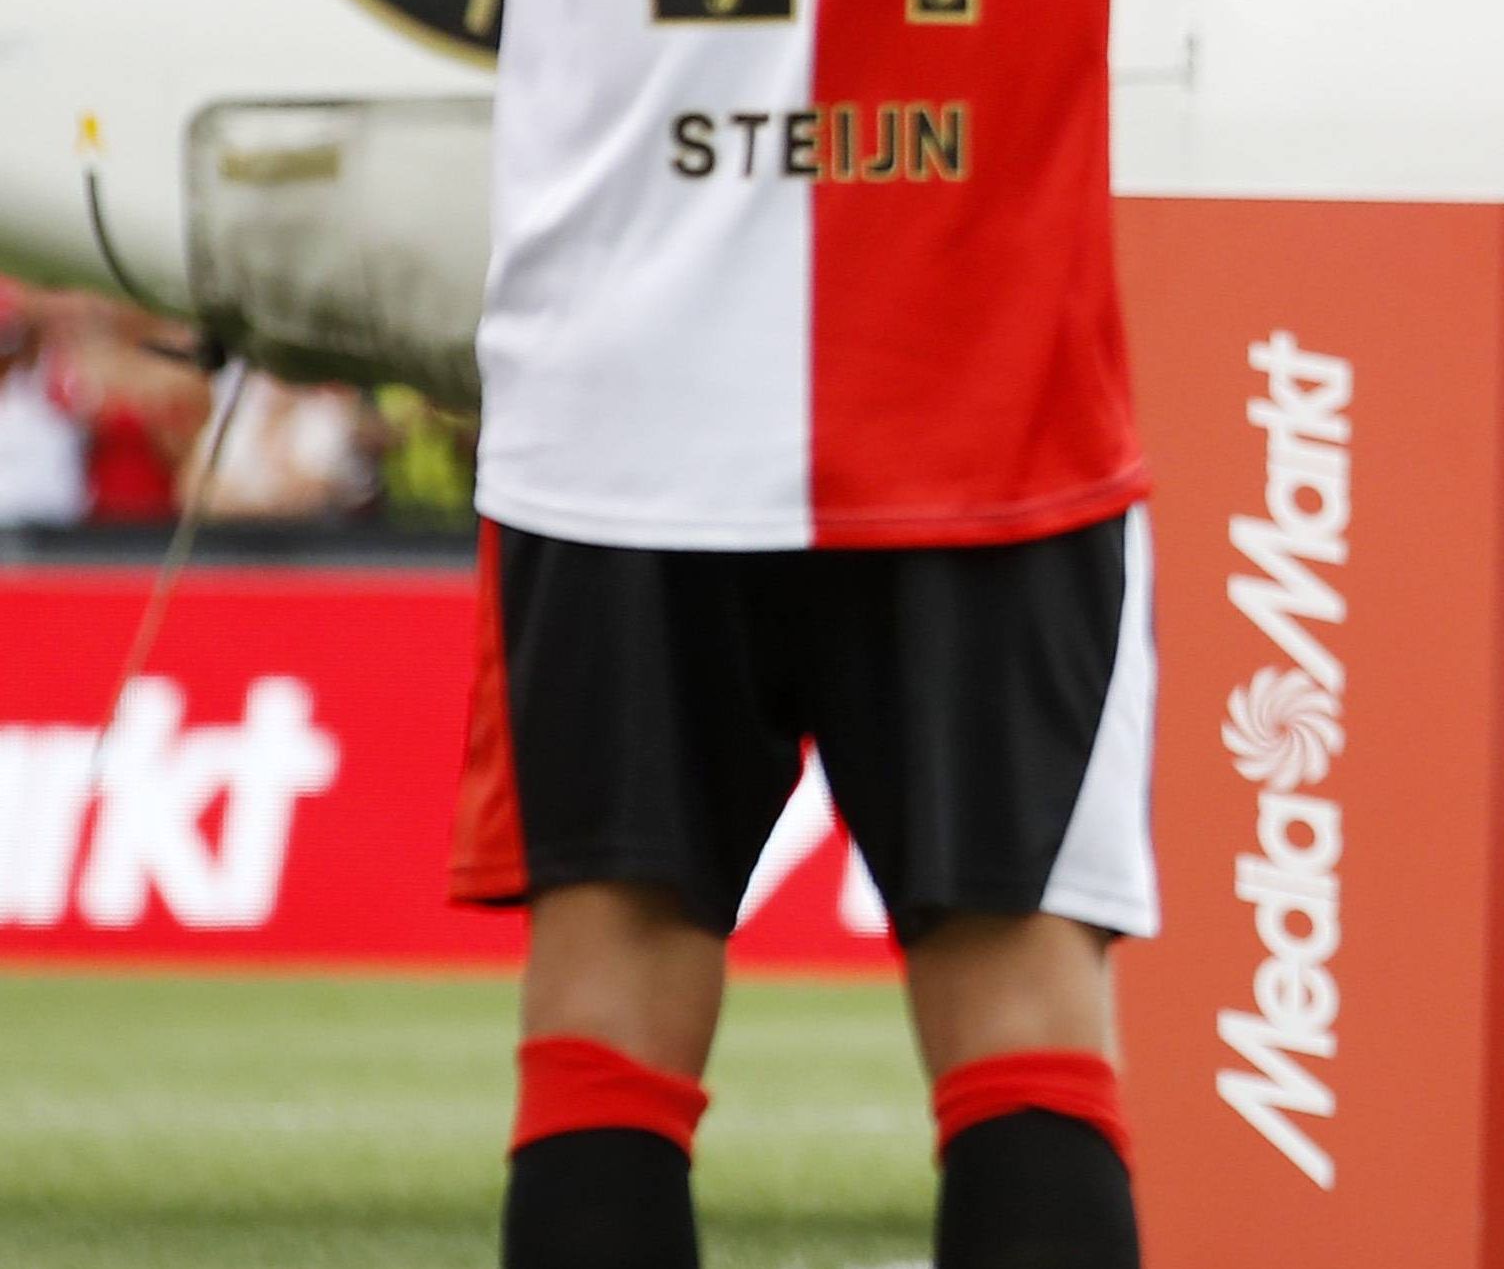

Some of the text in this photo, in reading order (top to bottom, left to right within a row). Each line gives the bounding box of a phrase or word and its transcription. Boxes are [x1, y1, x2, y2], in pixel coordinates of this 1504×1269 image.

[670, 102, 971, 183] STEIJN
[1214, 330, 1355, 1192] Media Markt
